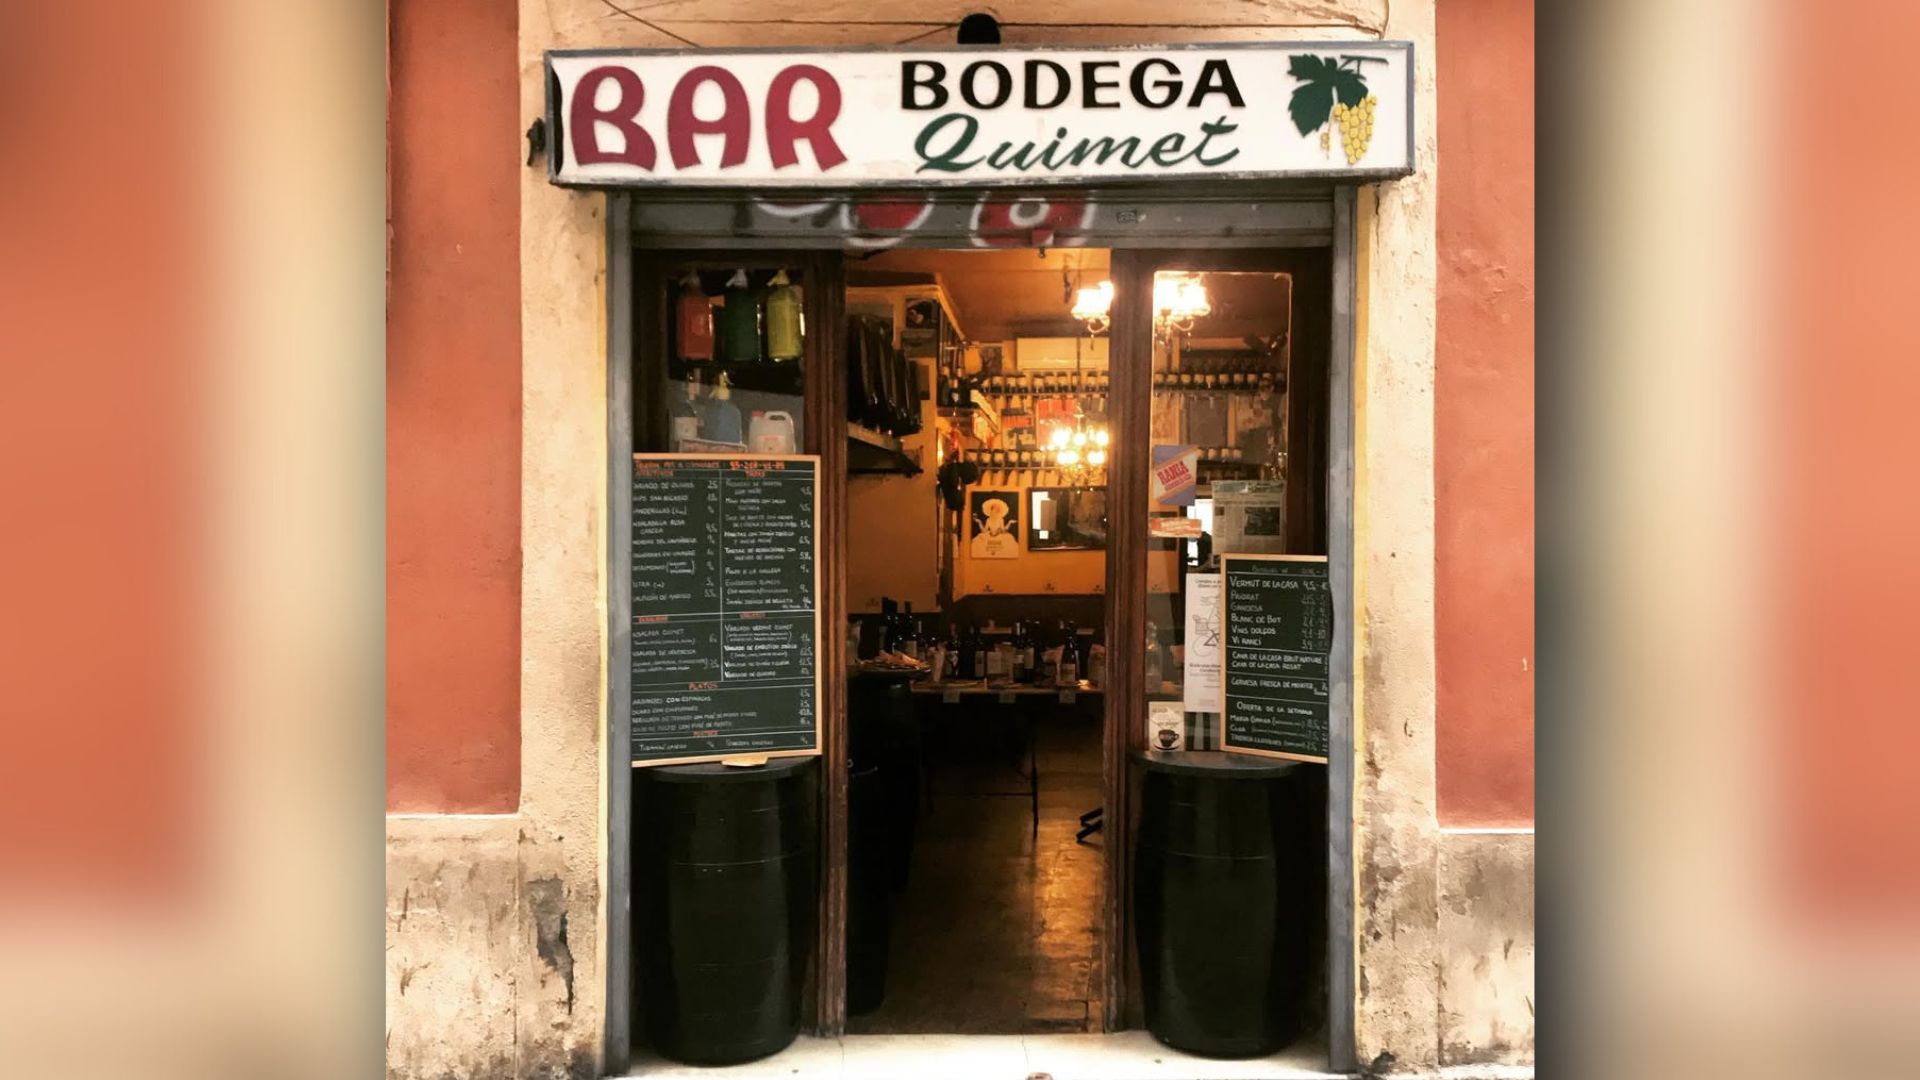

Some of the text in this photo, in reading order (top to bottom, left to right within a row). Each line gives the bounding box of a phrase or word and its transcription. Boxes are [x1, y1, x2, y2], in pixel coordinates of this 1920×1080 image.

[901, 58, 1246, 111] BODEGA
[570, 64, 848, 172] BAR
[914, 112, 1240, 174] Quimet
[1229, 576, 1260, 588] VERMUT
[1262, 580, 1272, 588] DE
[1272, 580, 1280, 588] LA
[1280, 580, 1299, 589] CASA
[1231, 591, 1260, 601] PRIORAT
[1231, 613, 1254, 623] BLANC
[1265, 705, 1274, 713] DE
